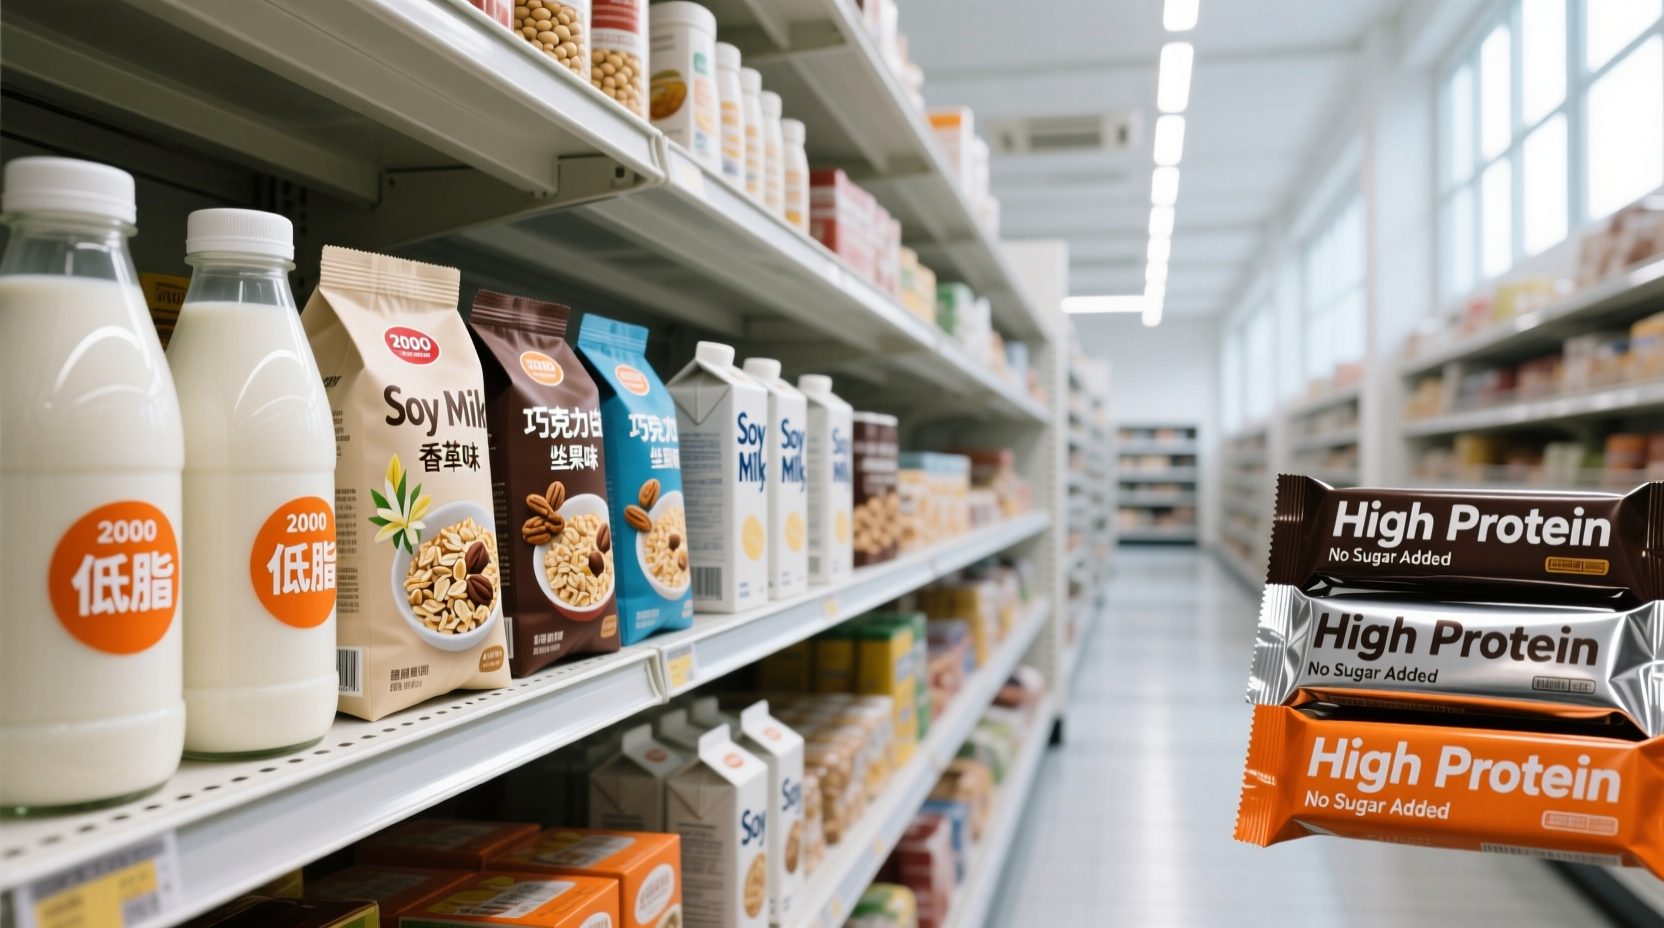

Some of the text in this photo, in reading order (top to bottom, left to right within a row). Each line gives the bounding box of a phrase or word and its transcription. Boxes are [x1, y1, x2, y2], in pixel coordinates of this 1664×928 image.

[388, 334, 432, 352] 2000
[384, 384, 438, 436] Soy
[447, 389, 487, 430] Milk
[737, 411, 767, 452] Soy
[419, 440, 481, 472] 香草味
[97, 518, 158, 545] 2000
[286, 512, 328, 534] 2000
[1332, 500, 1612, 548] High Protein
[267, 540, 337, 595] 低脂
[1328, 547, 1452, 568] No Sugar Added
[71, 551, 174, 617] 低脂
[1313, 612, 1599, 667] High Protein
[1307, 661, 1438, 684] No Sugar Added
[1307, 736, 1621, 803] High Protein
[1304, 790, 1451, 820] No Sugar Added
[741, 808, 767, 847] Soy
